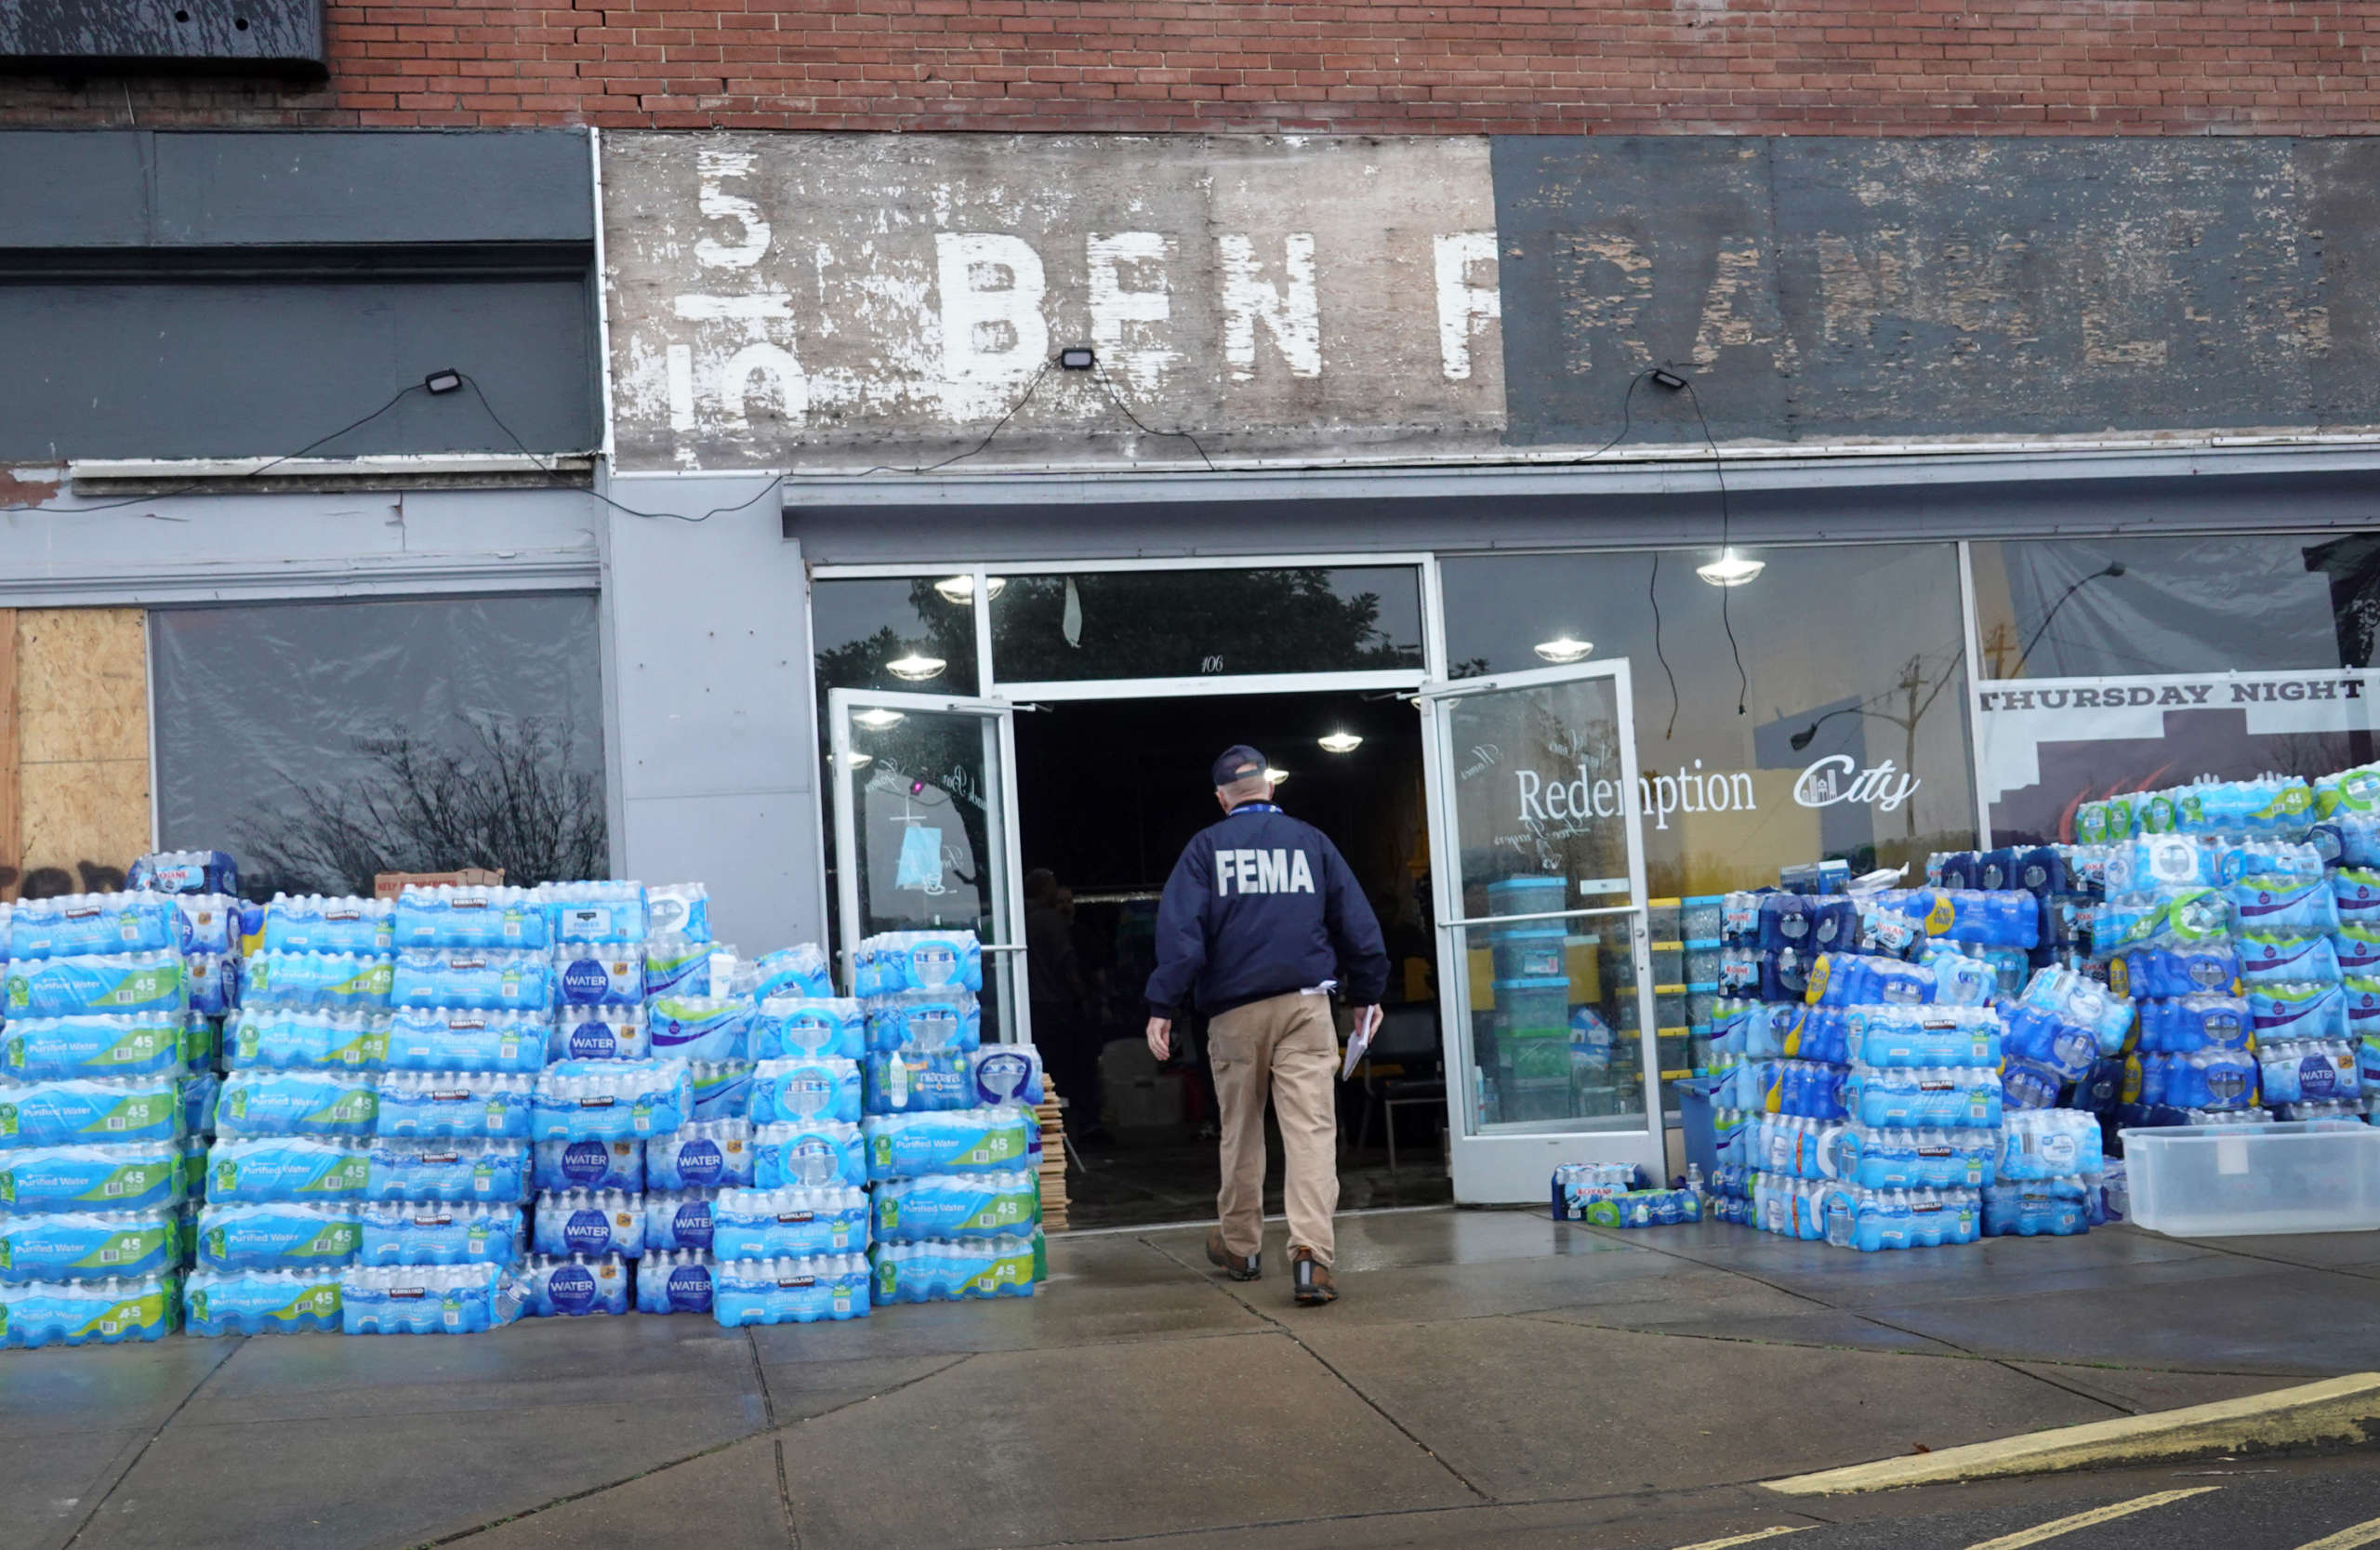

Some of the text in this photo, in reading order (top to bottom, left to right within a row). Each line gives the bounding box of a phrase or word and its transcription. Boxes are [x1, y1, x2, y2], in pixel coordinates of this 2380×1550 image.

[933, 231, 1321, 380] BEN
[1201, 655, 1223, 673] 106
[1979, 680, 2365, 711] THURSDAY NIGHT
[1515, 754, 1922, 829] Redemption City
[1214, 848, 1316, 897] FEMA
[135, 978, 156, 990] 45
[565, 975, 606, 987] WATER
[70, 1042, 98, 1051] Water
[134, 1035, 153, 1047] 45
[573, 1037, 615, 1049] WATER
[919, 1071, 960, 1086] niagara
[2299, 1070, 2334, 1081] WATER
[353, 1096, 372, 1110] 45
[128, 1105, 149, 1117] 45
[896, 1139, 959, 1148] Purified Water
[990, 1138, 1008, 1151] 45
[565, 1155, 607, 1165] WATER
[679, 1155, 721, 1167] WATER
[345, 1165, 365, 1178] 45
[18, 1177, 89, 1187] Purified Water
[125, 1172, 144, 1184] 45
[997, 1201, 1017, 1214] 45
[334, 1229, 352, 1242] 45
[567, 1225, 609, 1238] WATER
[230, 1233, 299, 1243] Purified Water
[15, 1244, 85, 1253] Purified Water
[121, 1239, 140, 1250] 45
[549, 1280, 593, 1292] WATER
[668, 1280, 712, 1292] WATER
